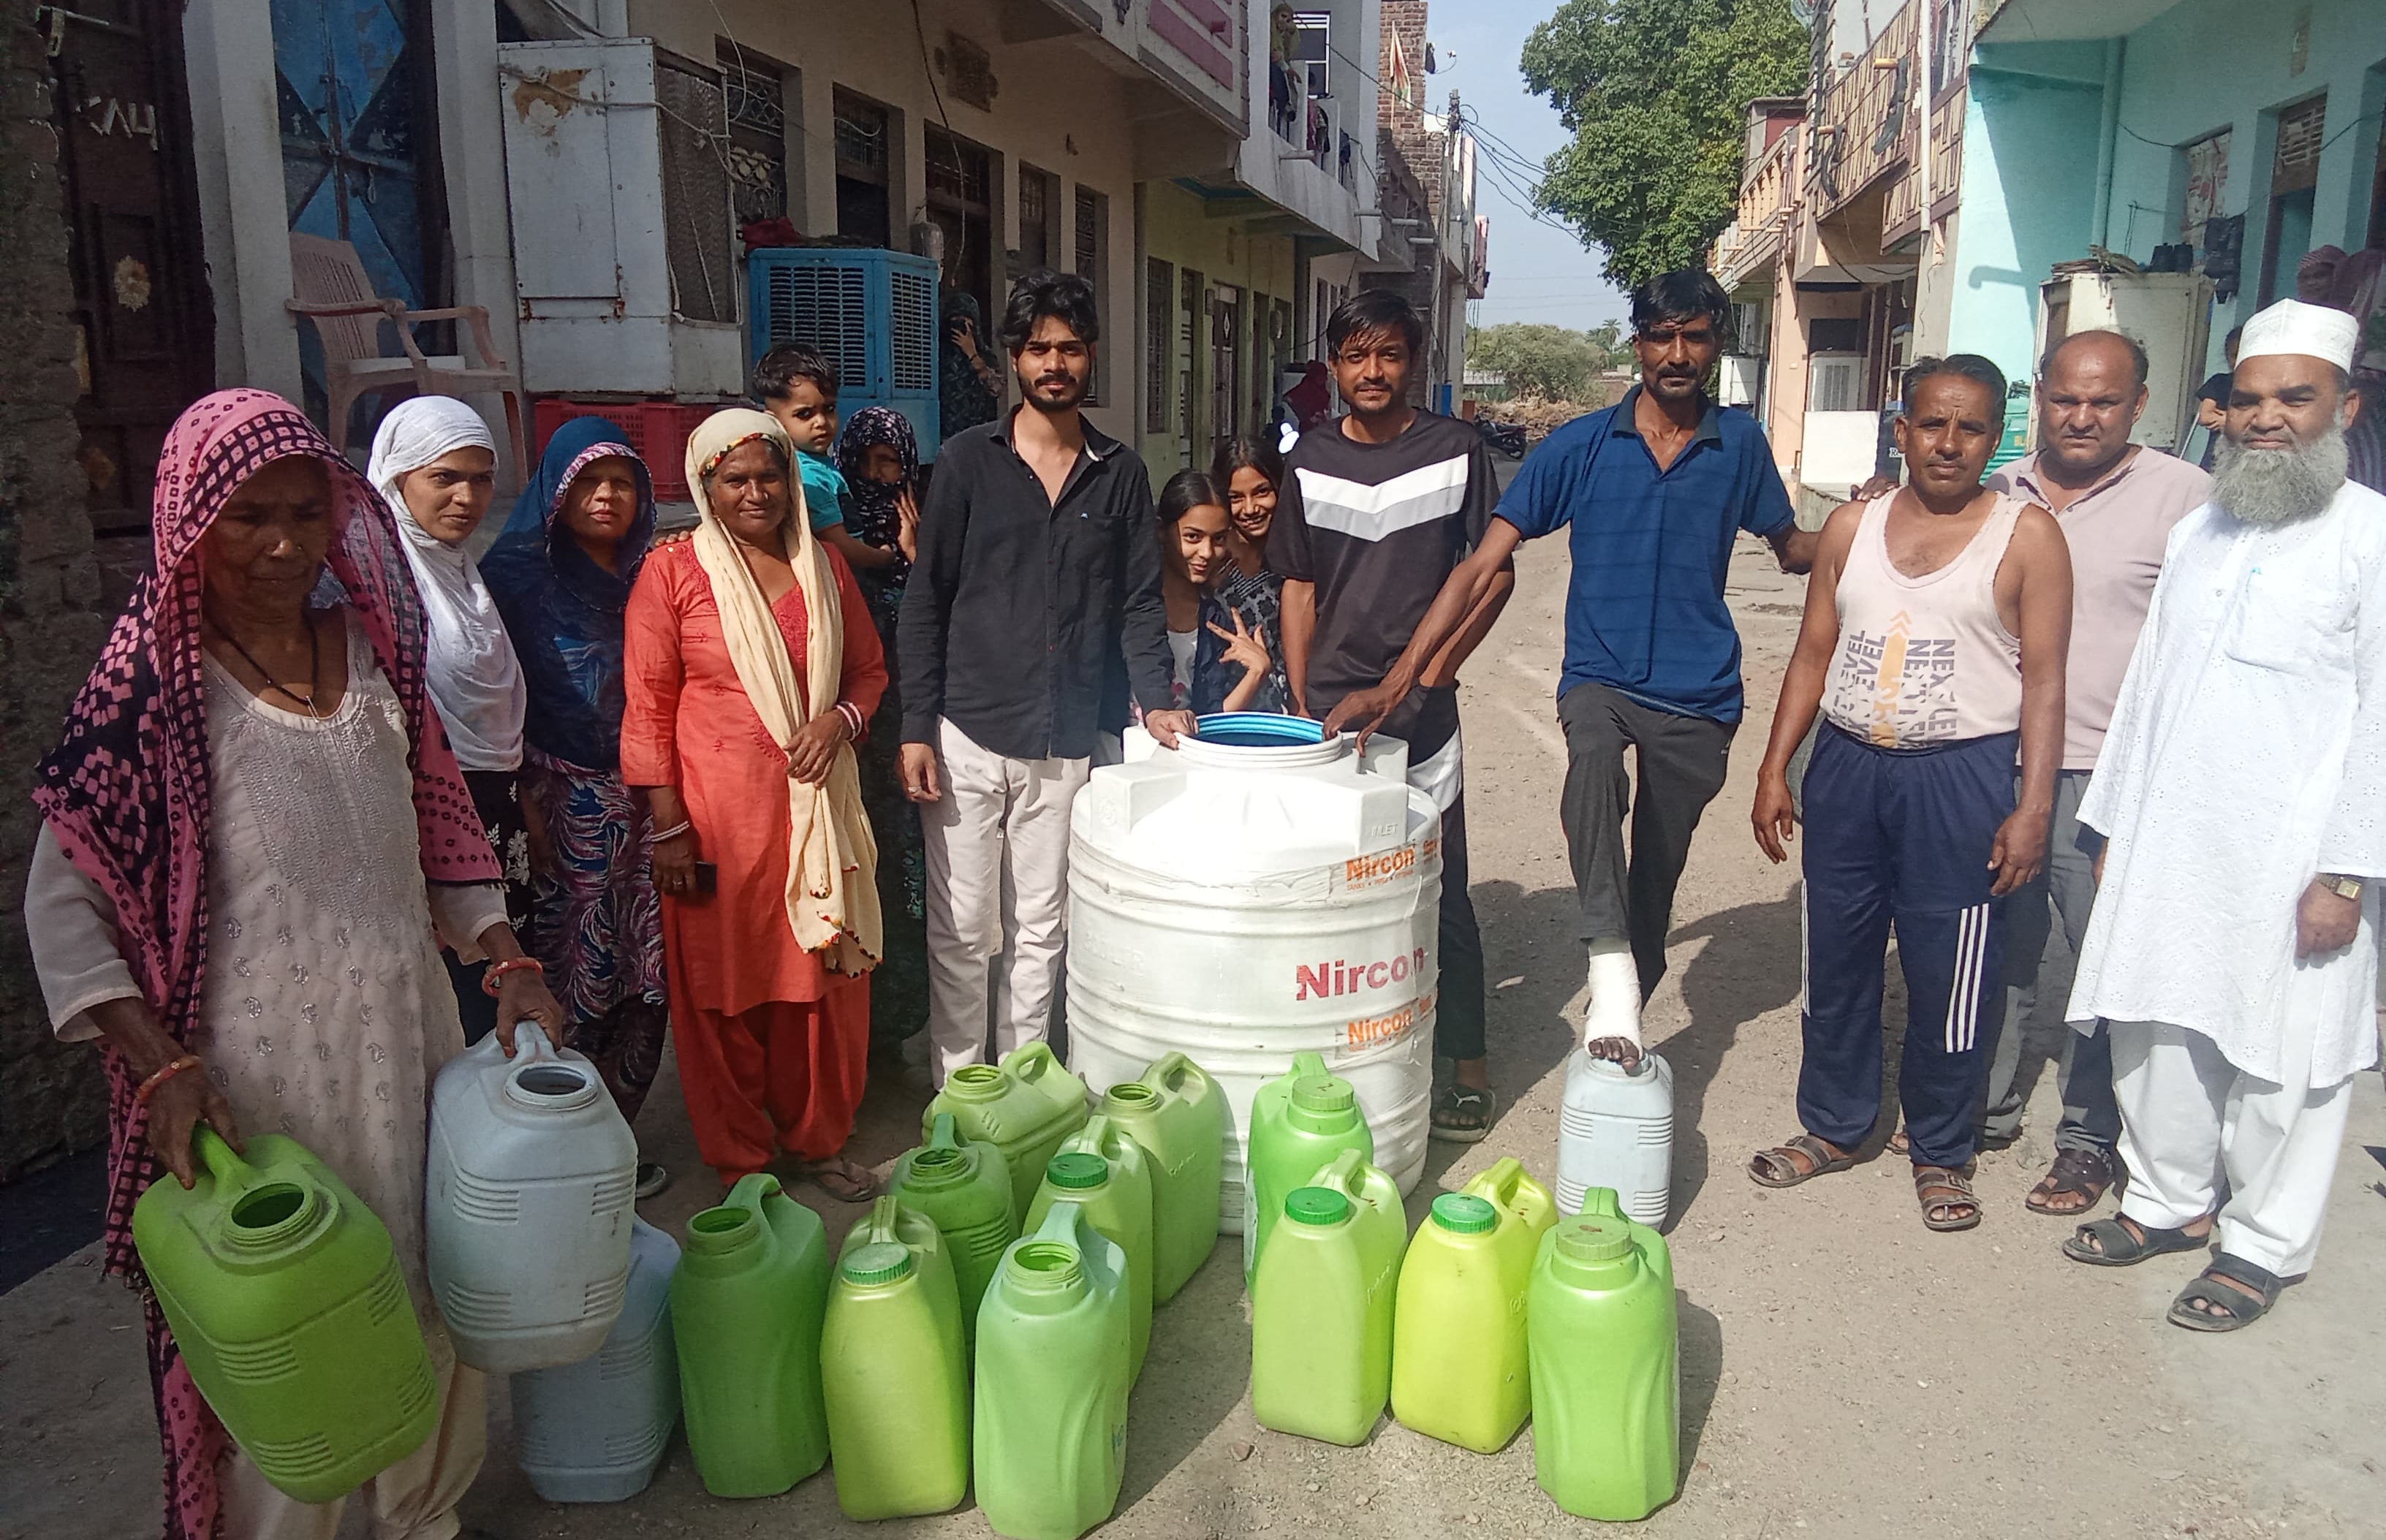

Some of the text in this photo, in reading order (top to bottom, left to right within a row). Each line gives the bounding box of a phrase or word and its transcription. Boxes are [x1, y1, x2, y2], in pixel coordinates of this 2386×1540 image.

[1371, 823, 1398, 837] INLET
[1346, 846, 1416, 882] Nircon
[1296, 947, 1425, 1001] Nircon
[1347, 1008, 1414, 1045] Nircon
